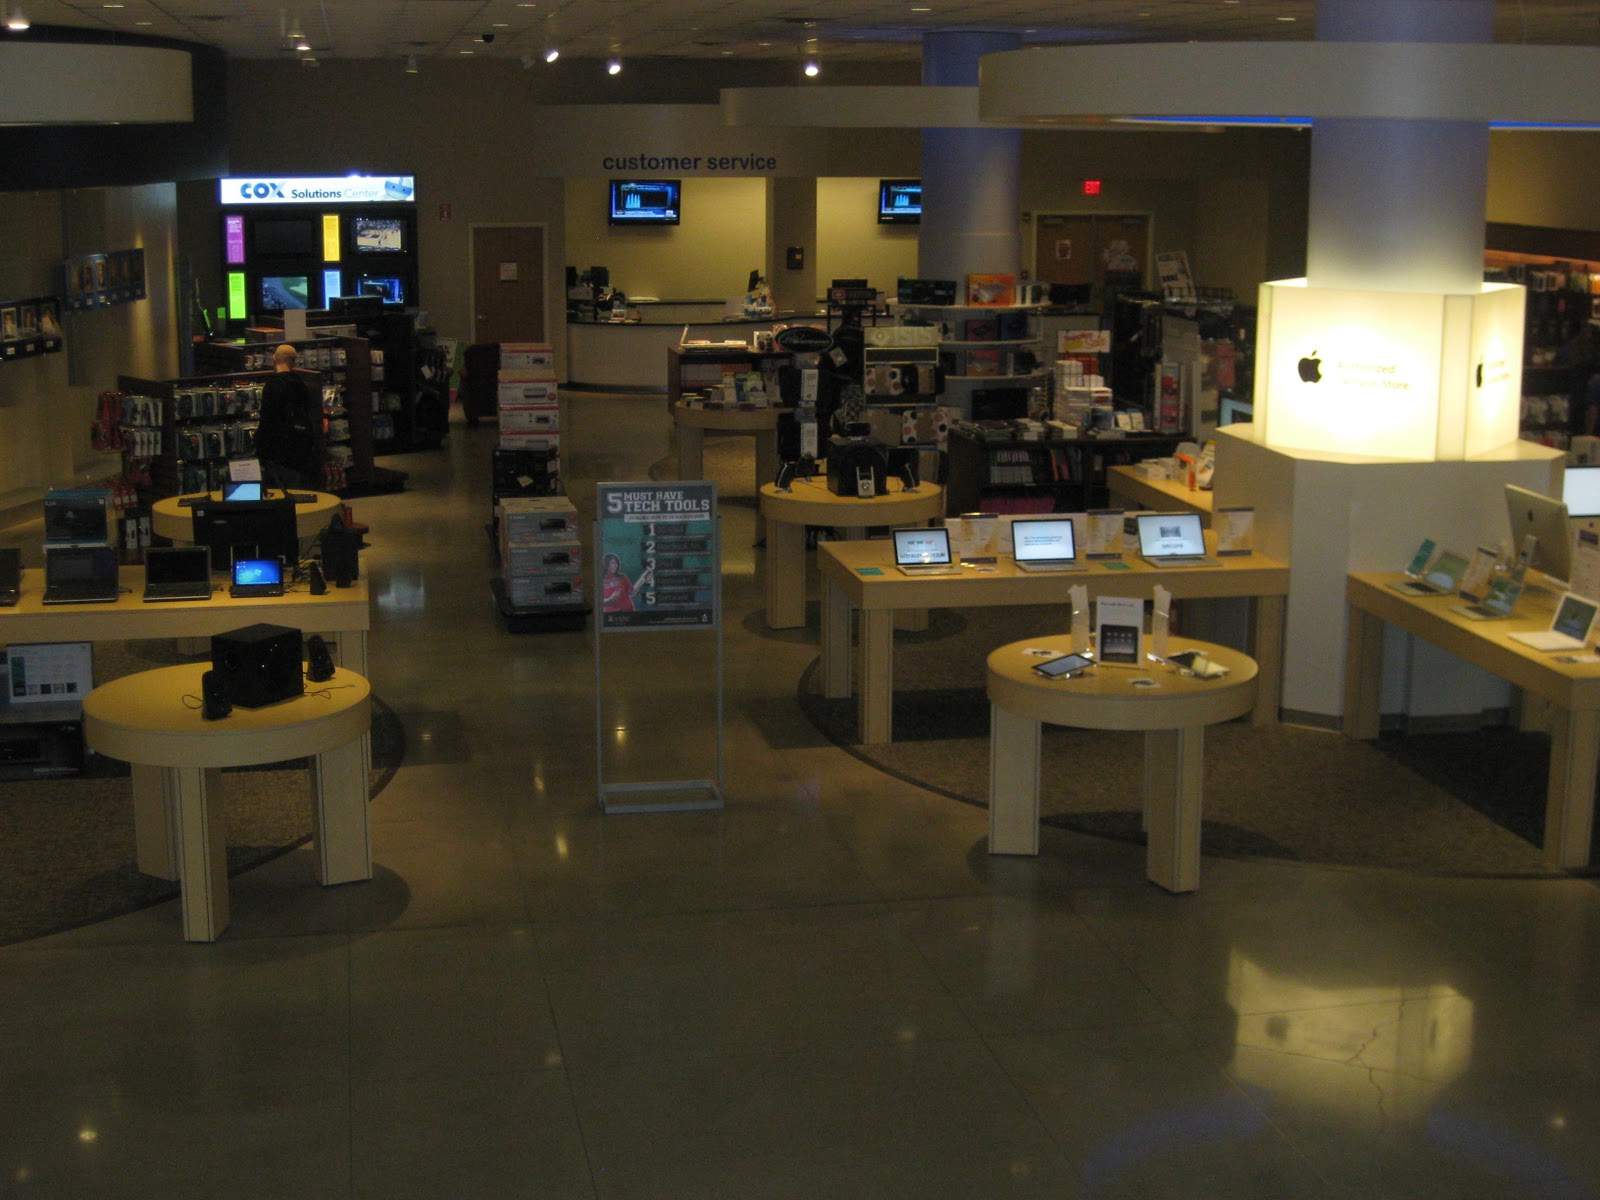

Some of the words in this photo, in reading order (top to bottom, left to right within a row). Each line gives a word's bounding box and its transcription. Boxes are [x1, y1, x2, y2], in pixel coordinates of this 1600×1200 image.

[603, 154, 701, 170] customer
[707, 154, 777, 170] service
[240, 182, 286, 199] COX
[291, 189, 342, 199] Solutions
[344, 189, 379, 198] Center
[606, 492, 623, 512] 5
[624, 491, 652, 501] MUST
[656, 490, 684, 500] HAVE
[624, 500, 661, 512] TECH
[664, 499, 710, 512] TOOLS
[649, 523, 656, 536] 1
[645, 541, 656, 553] 2
[645, 558, 656, 571] 3
[645, 592, 657, 604] 5
